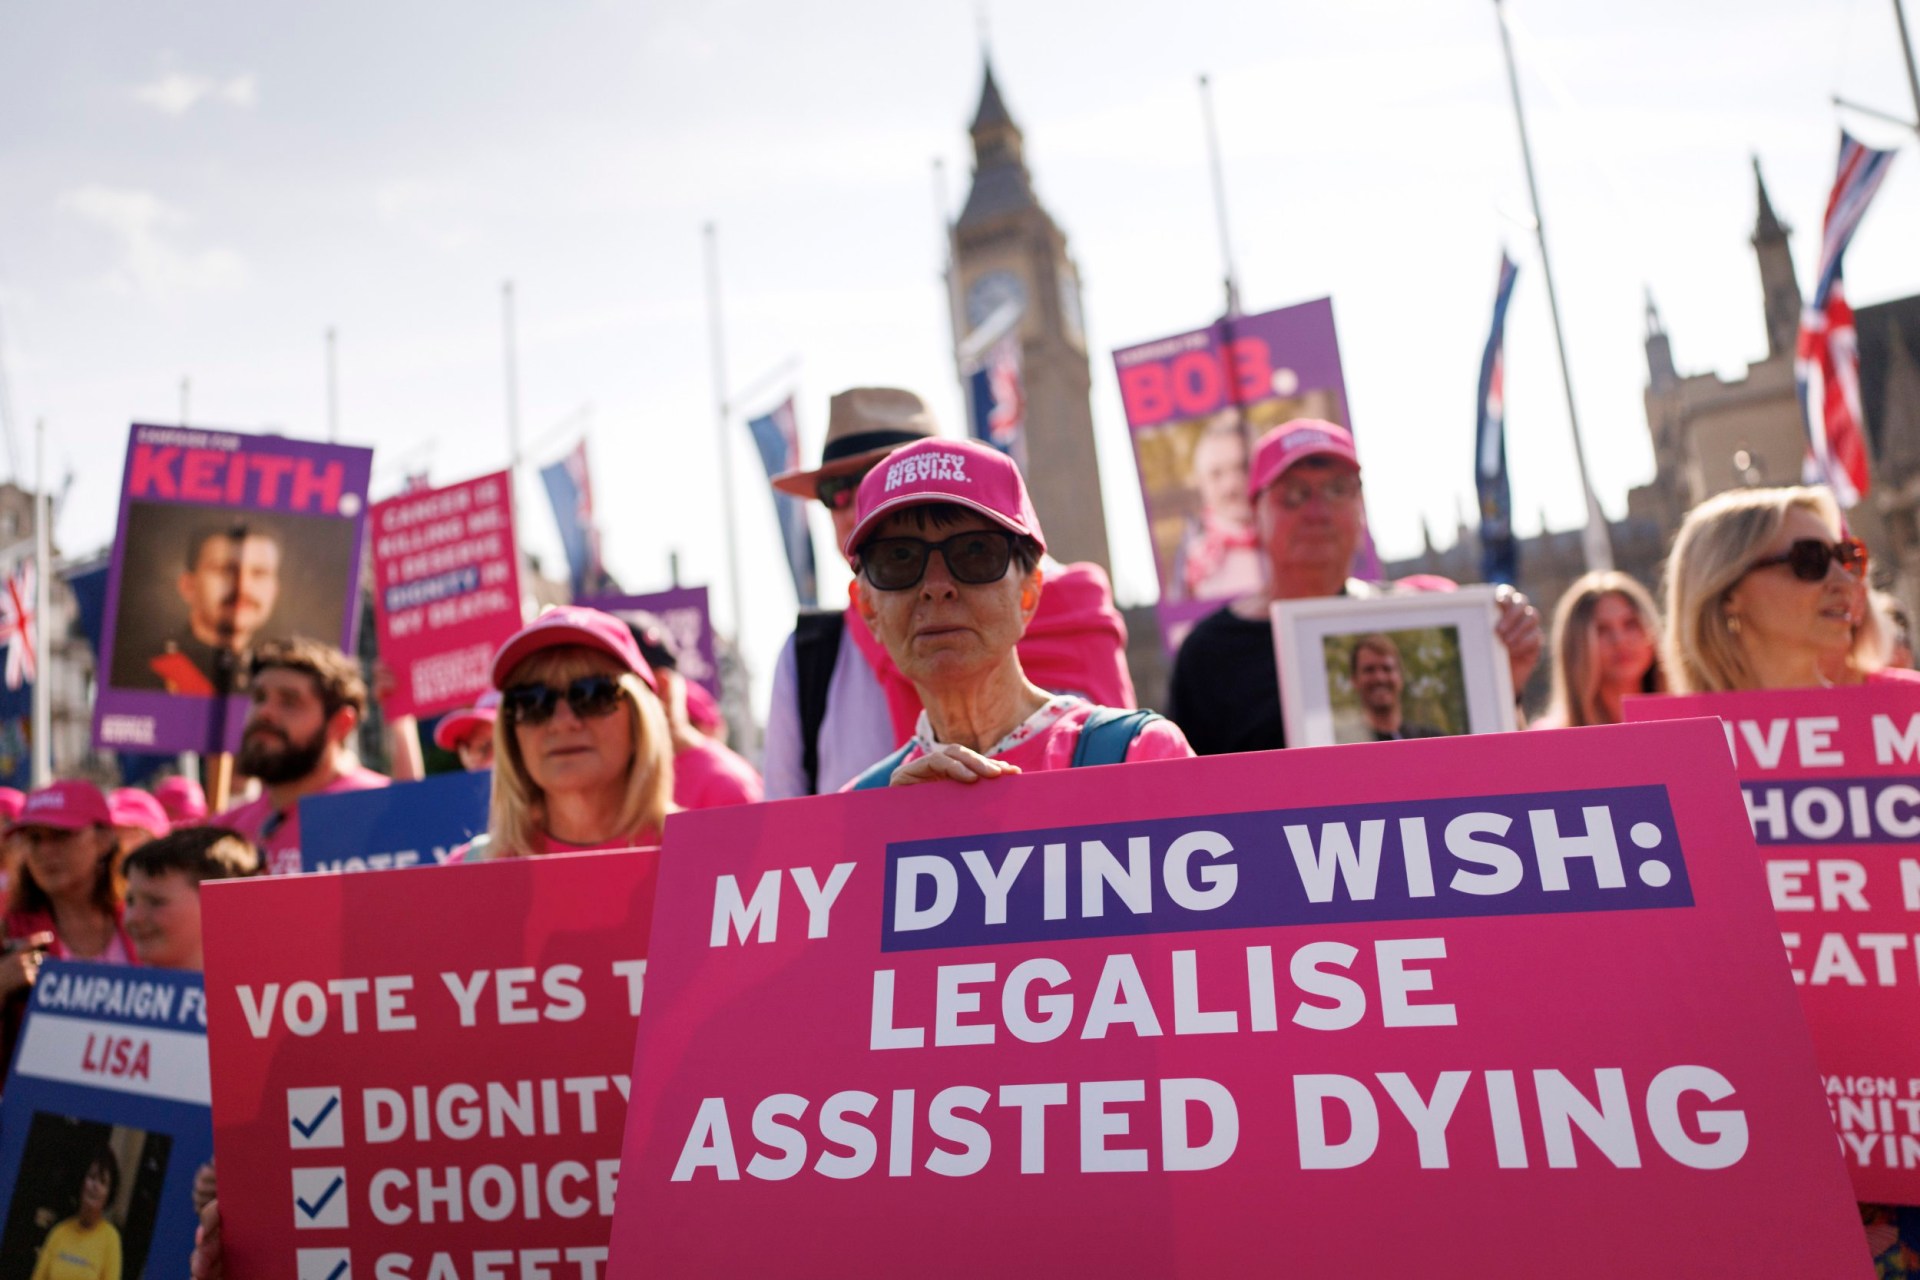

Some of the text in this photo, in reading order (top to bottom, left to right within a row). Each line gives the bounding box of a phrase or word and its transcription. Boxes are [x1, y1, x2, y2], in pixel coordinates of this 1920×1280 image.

[1121, 337, 1298, 427] BOB.
[130, 444, 360, 517] KEITH.
[884, 469, 972, 492] IN DYING.
[886, 458, 965, 480] DIGNITY
[888, 452, 965, 472] CAMPAIGN FOR
[383, 482, 497, 530] CANCER IS
[379, 517, 463, 557] KILLING
[388, 536, 499, 581] I DESERVE
[387, 563, 507, 607] DIGNITY IN
[389, 610, 422, 636] MY
[709, 806, 1671, 948] MY DYING WISH:
[1781, 931, 1920, 987] AT
[37, 972, 176, 1022] CAMPAIGN
[236, 975, 416, 1039] VOTE
[441, 964, 586, 1027] YES
[870, 937, 1458, 1051] LEGALISE
[81, 1032, 152, 1082] LISA
[363, 1075, 631, 1143] DIGNIT
[1821, 1075, 1897, 1098] AIGN
[670, 1065, 1749, 1183] ASSISTED DYING
[1826, 1096, 1920, 1134] NIT
